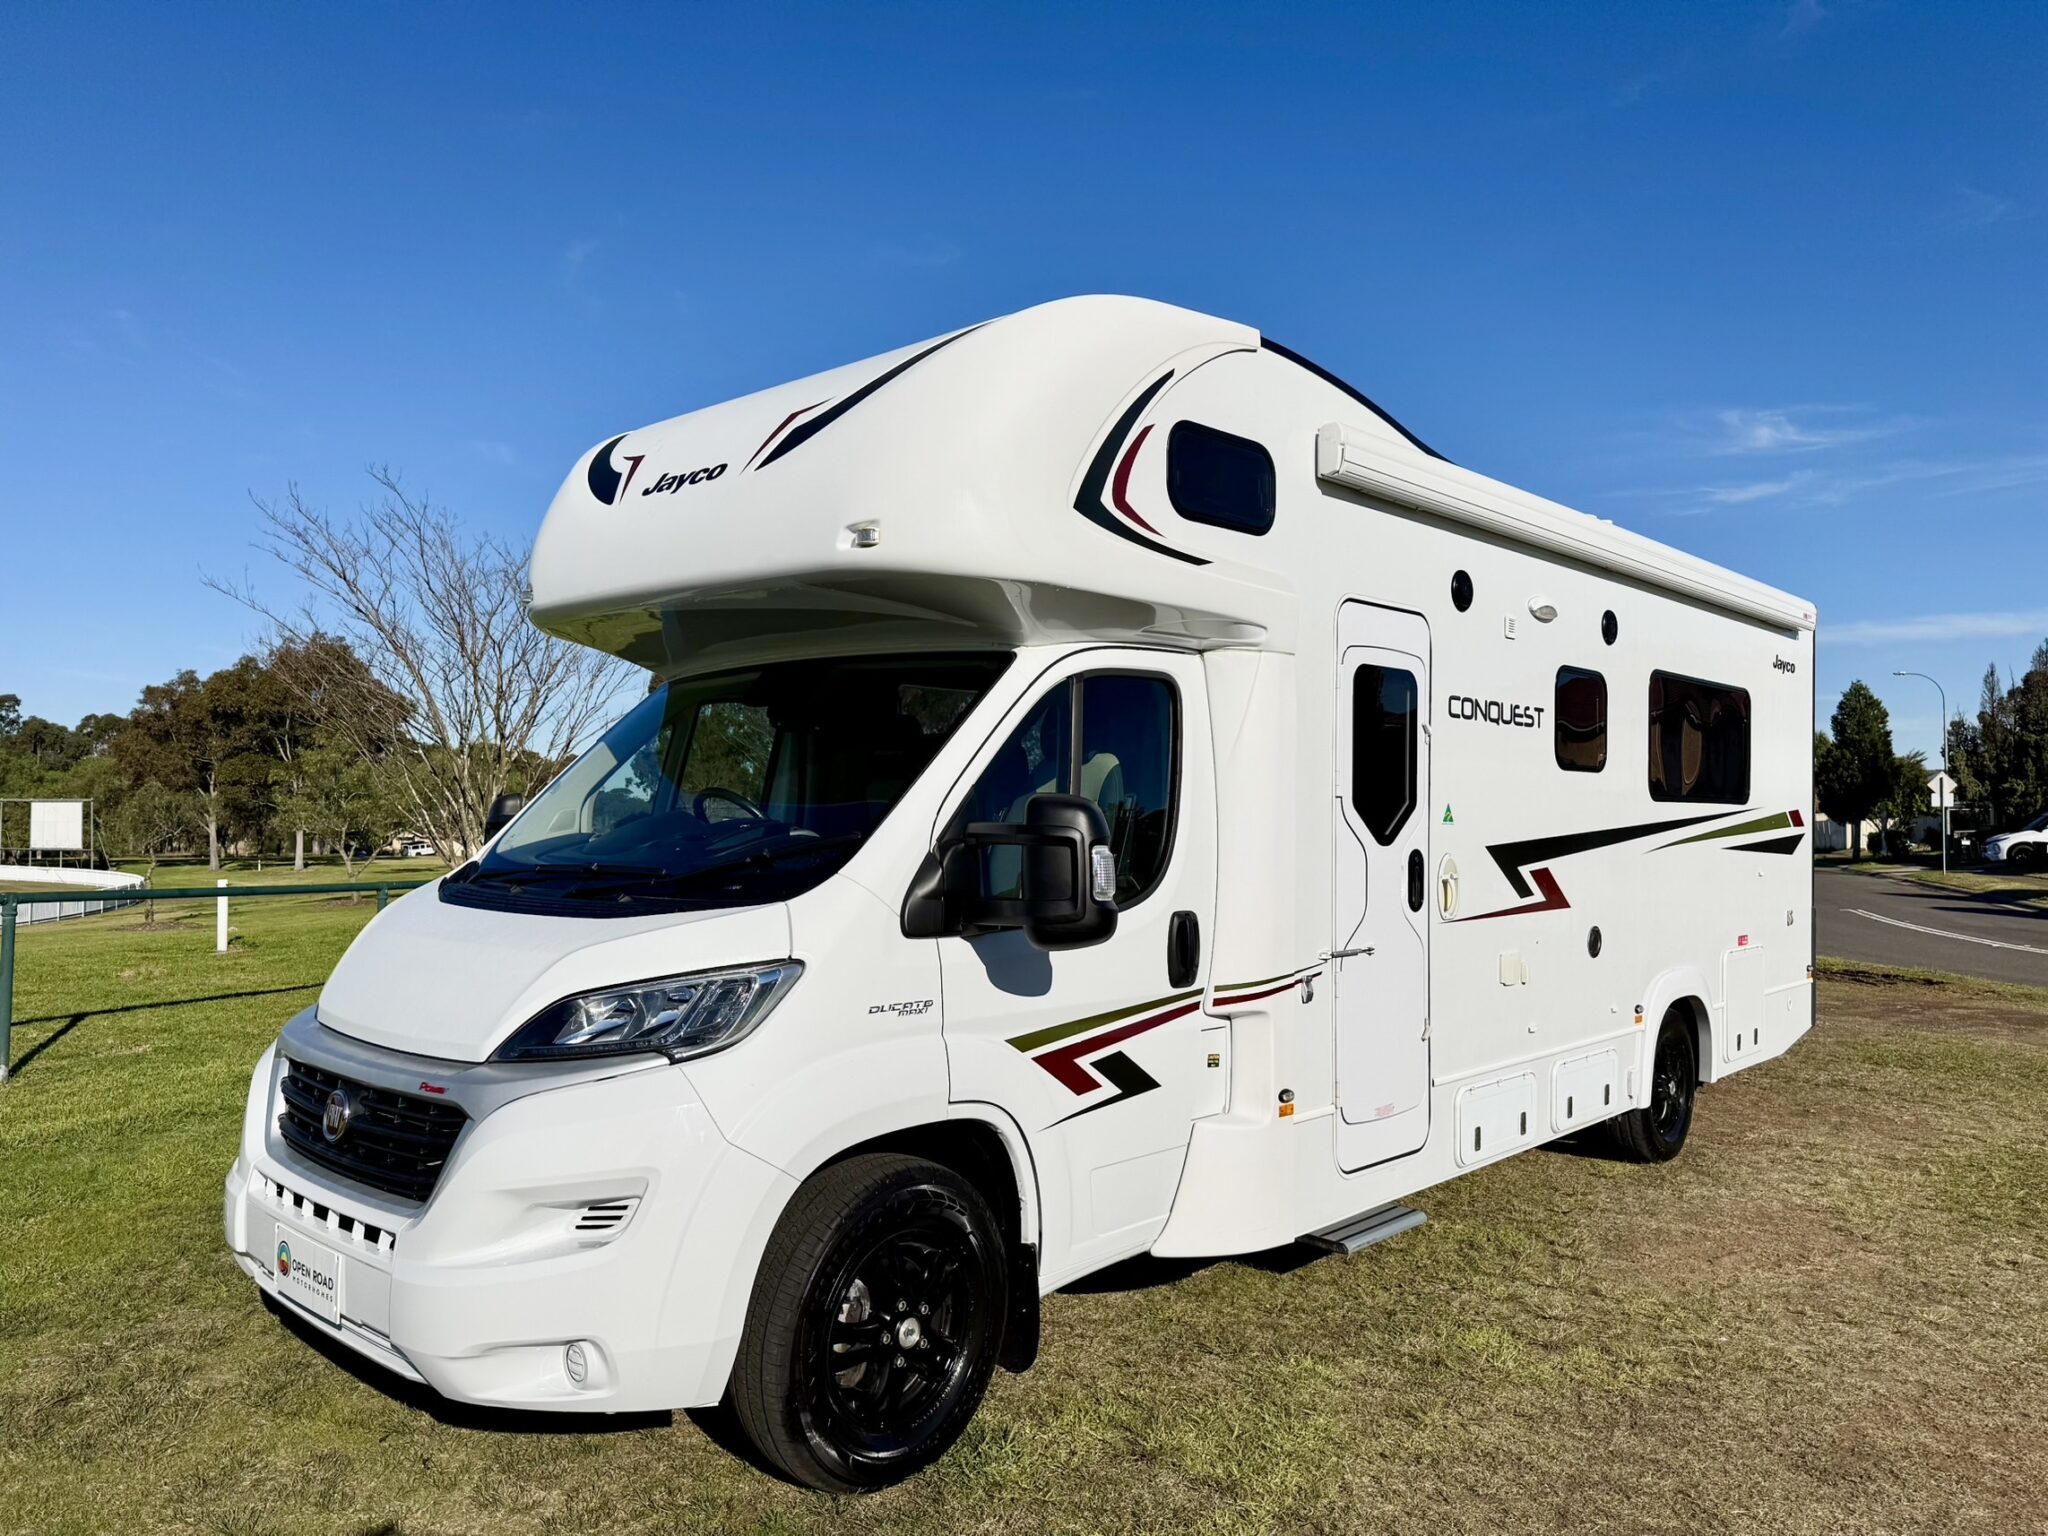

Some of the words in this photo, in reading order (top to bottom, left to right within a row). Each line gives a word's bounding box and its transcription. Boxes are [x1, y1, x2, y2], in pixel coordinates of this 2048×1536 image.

[641, 463, 729, 497] Jayco
[1772, 653, 1796, 674] Jayco
[1448, 695, 1544, 729] CONQUEST
[868, 1000, 933, 1014] DUCATO
[292, 1259, 310, 1278] OPEN
[313, 1270, 333, 1290] ROAD
[293, 1276, 333, 1302] MOTORHOMES
